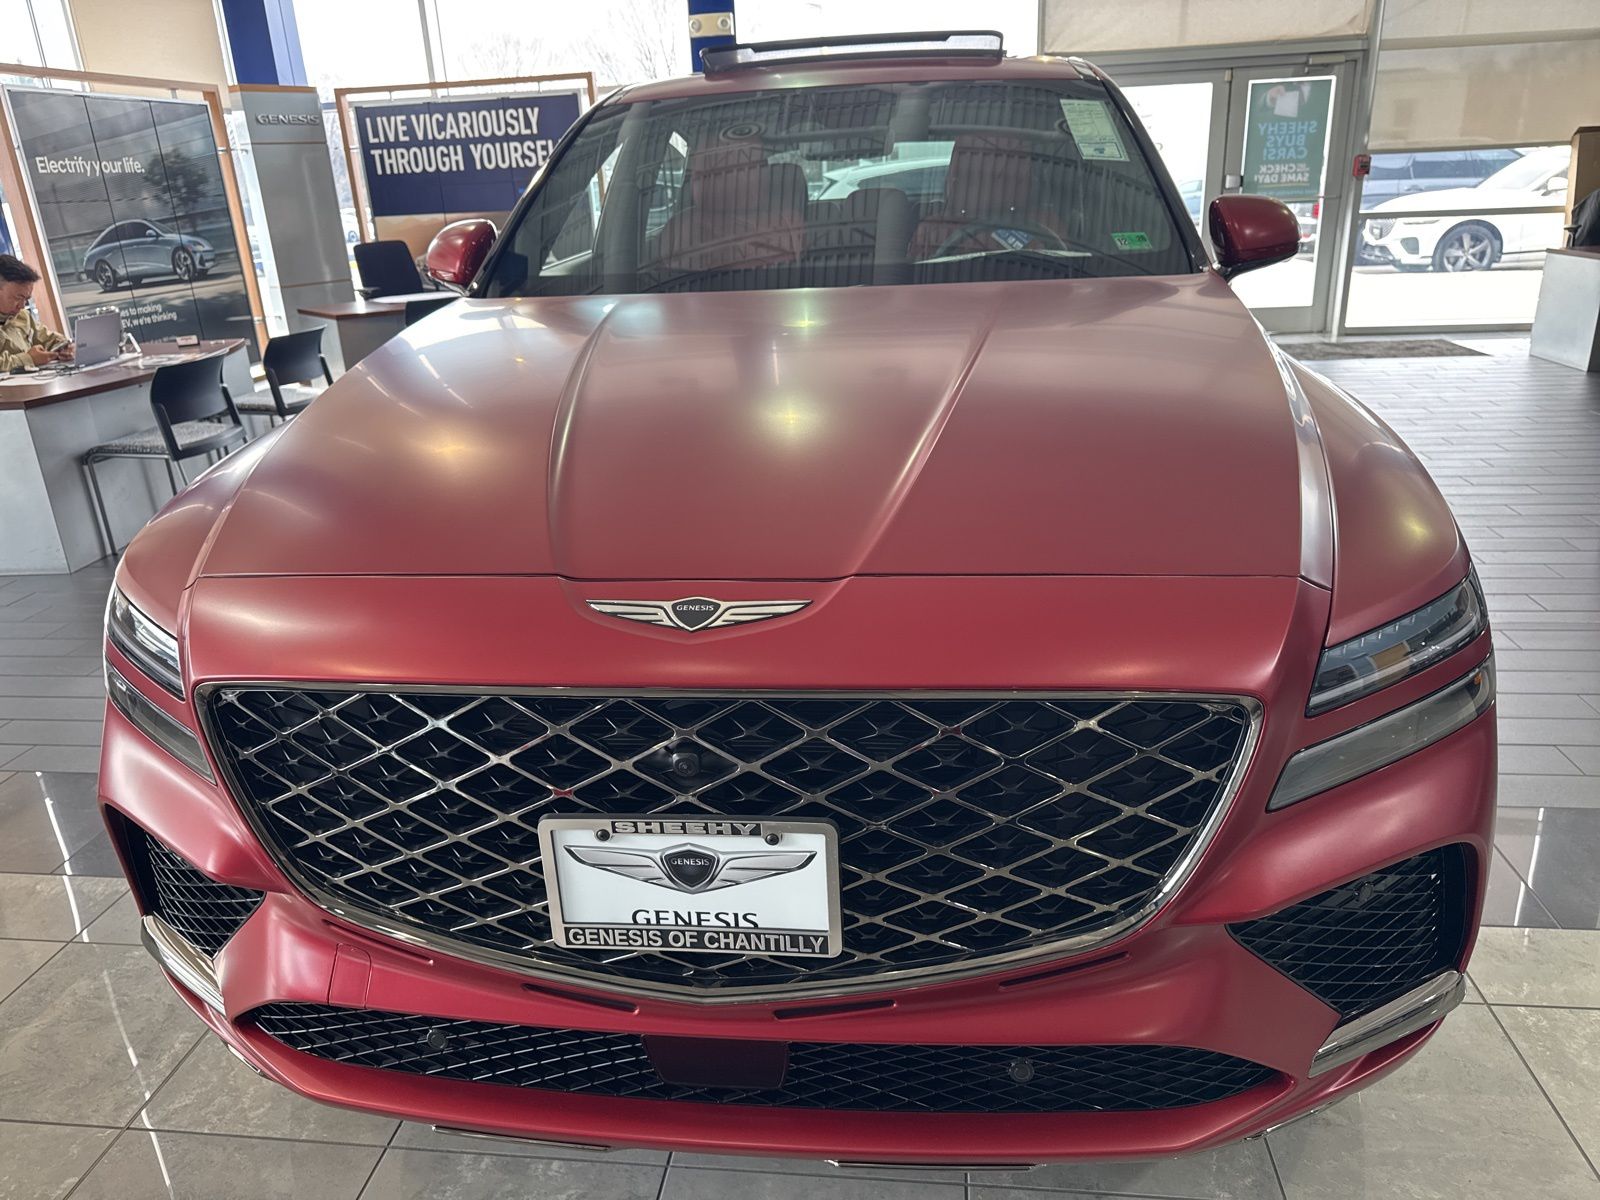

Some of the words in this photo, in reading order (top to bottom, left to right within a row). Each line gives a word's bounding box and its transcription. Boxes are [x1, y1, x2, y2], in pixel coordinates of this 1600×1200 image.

[257, 113, 320, 126] GENESIS
[366, 115, 410, 143] LIVE
[411, 107, 539, 141] VICARIOUSLY
[35, 156, 91, 177] Electrify
[92, 160, 123, 177] your
[123, 156, 145, 174] life.
[370, 144, 464, 176] THROUGH
[137, 303, 162, 315] making
[151, 311, 178, 323] thinking
[614, 821, 758, 835] SHEEHY
[670, 857, 710, 866] GENESIS
[632, 909, 758, 928] GENESIS
[568, 928, 662, 947] GENESIS
[668, 930, 697, 949] OF
[704, 931, 825, 953] CHANTILLY
